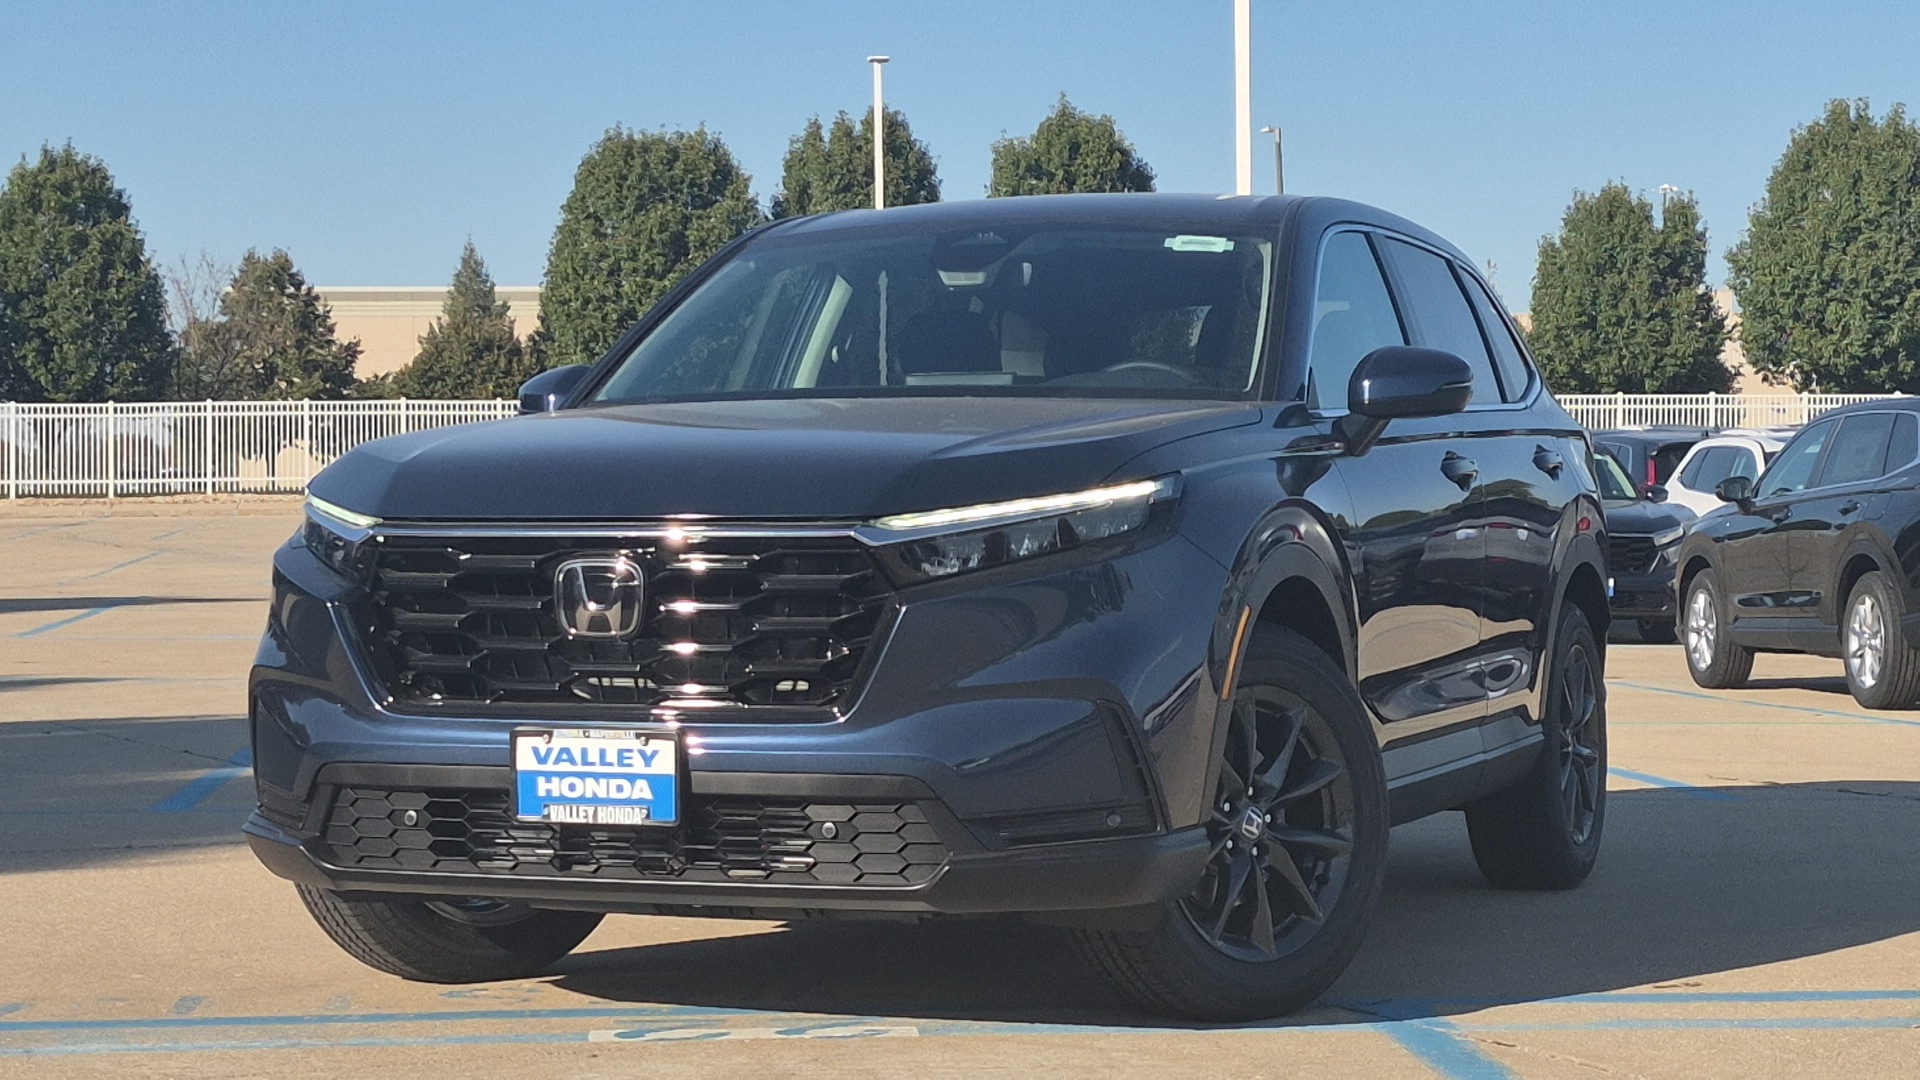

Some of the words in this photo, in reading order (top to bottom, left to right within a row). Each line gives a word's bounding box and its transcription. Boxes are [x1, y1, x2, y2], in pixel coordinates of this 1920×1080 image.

[531, 746, 660, 768] VALLEY
[537, 776, 654, 800] HONDA
[549, 805, 595, 824] VALLEY
[597, 806, 643, 825] HONDA
